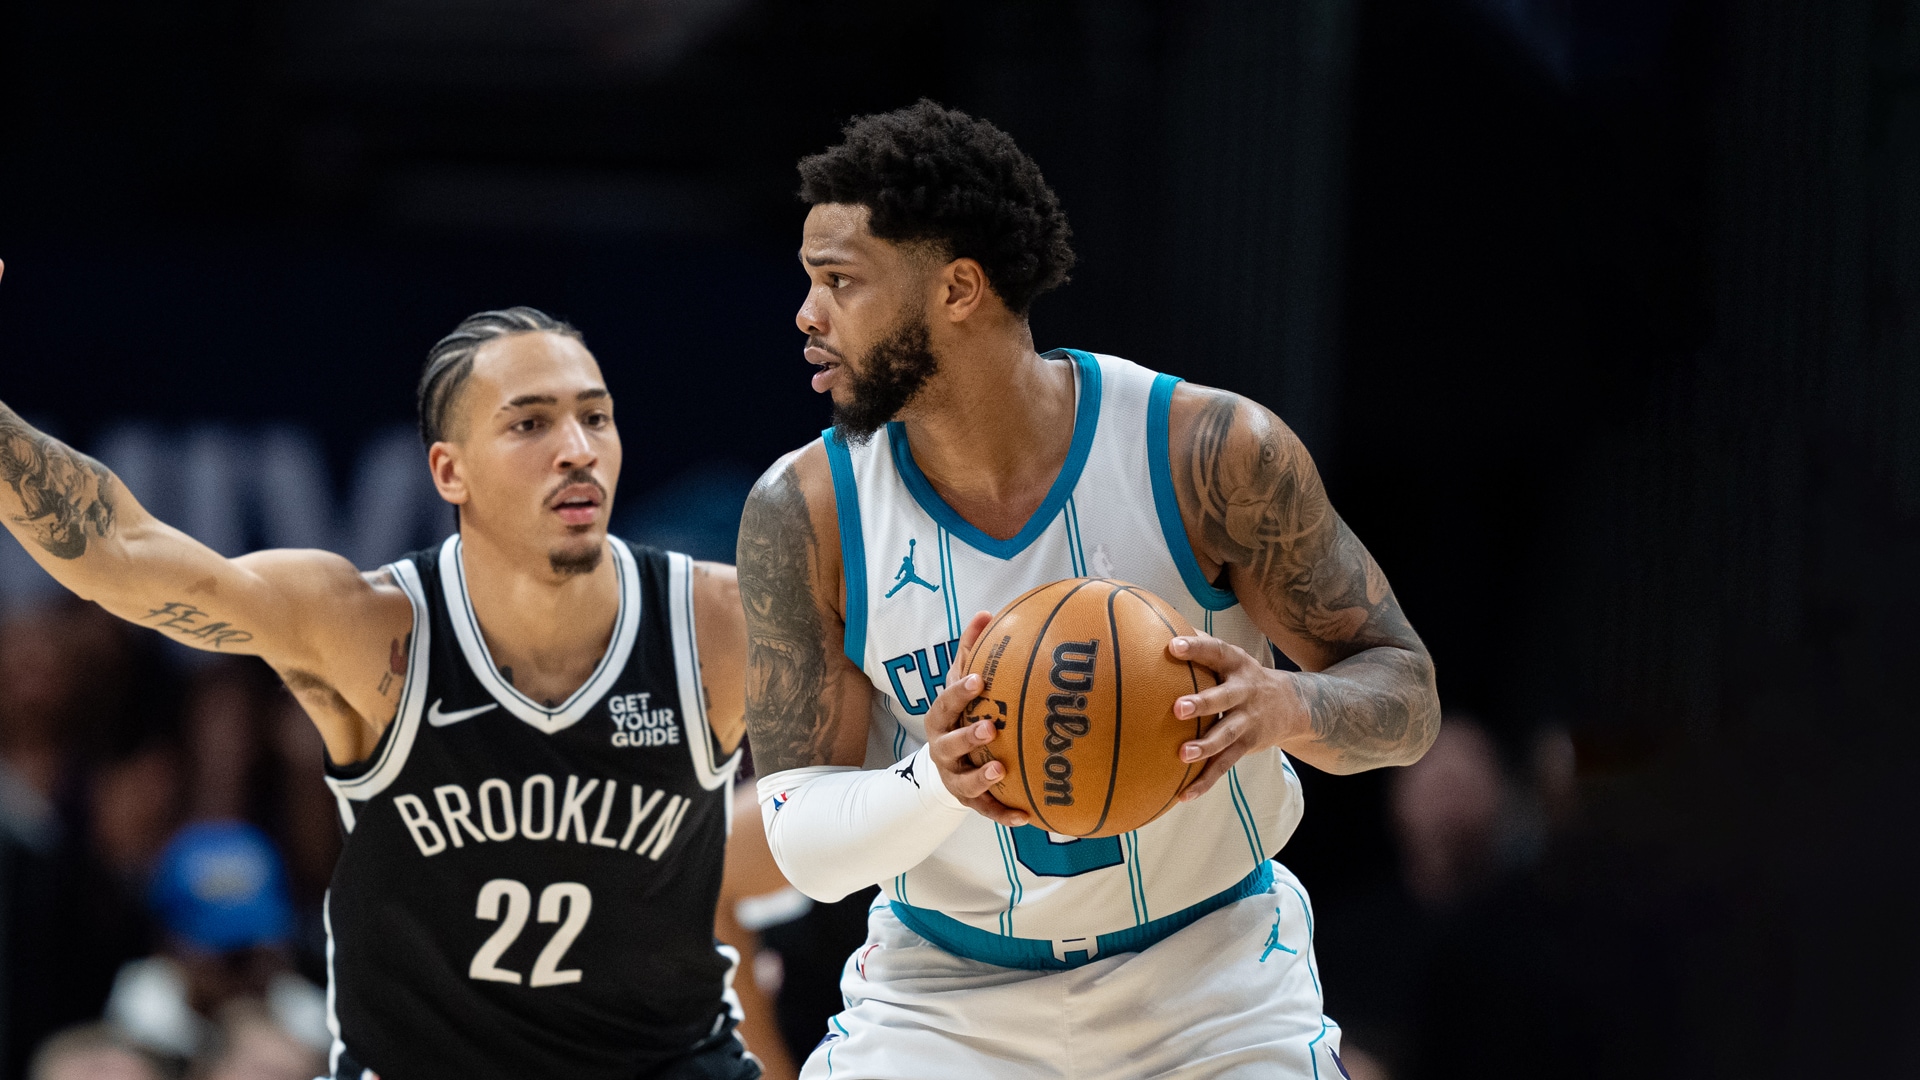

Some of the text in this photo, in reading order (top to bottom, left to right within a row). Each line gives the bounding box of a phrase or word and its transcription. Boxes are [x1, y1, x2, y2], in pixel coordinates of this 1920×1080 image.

[987, 659, 999, 676] GAME
[608, 692, 651, 714] GET
[611, 708, 675, 732] YOUR
[1043, 639, 1099, 806] Wilson
[611, 725, 680, 748] GUIDE
[393, 774, 691, 861] BROOKLYN
[469, 878, 593, 988] 22
